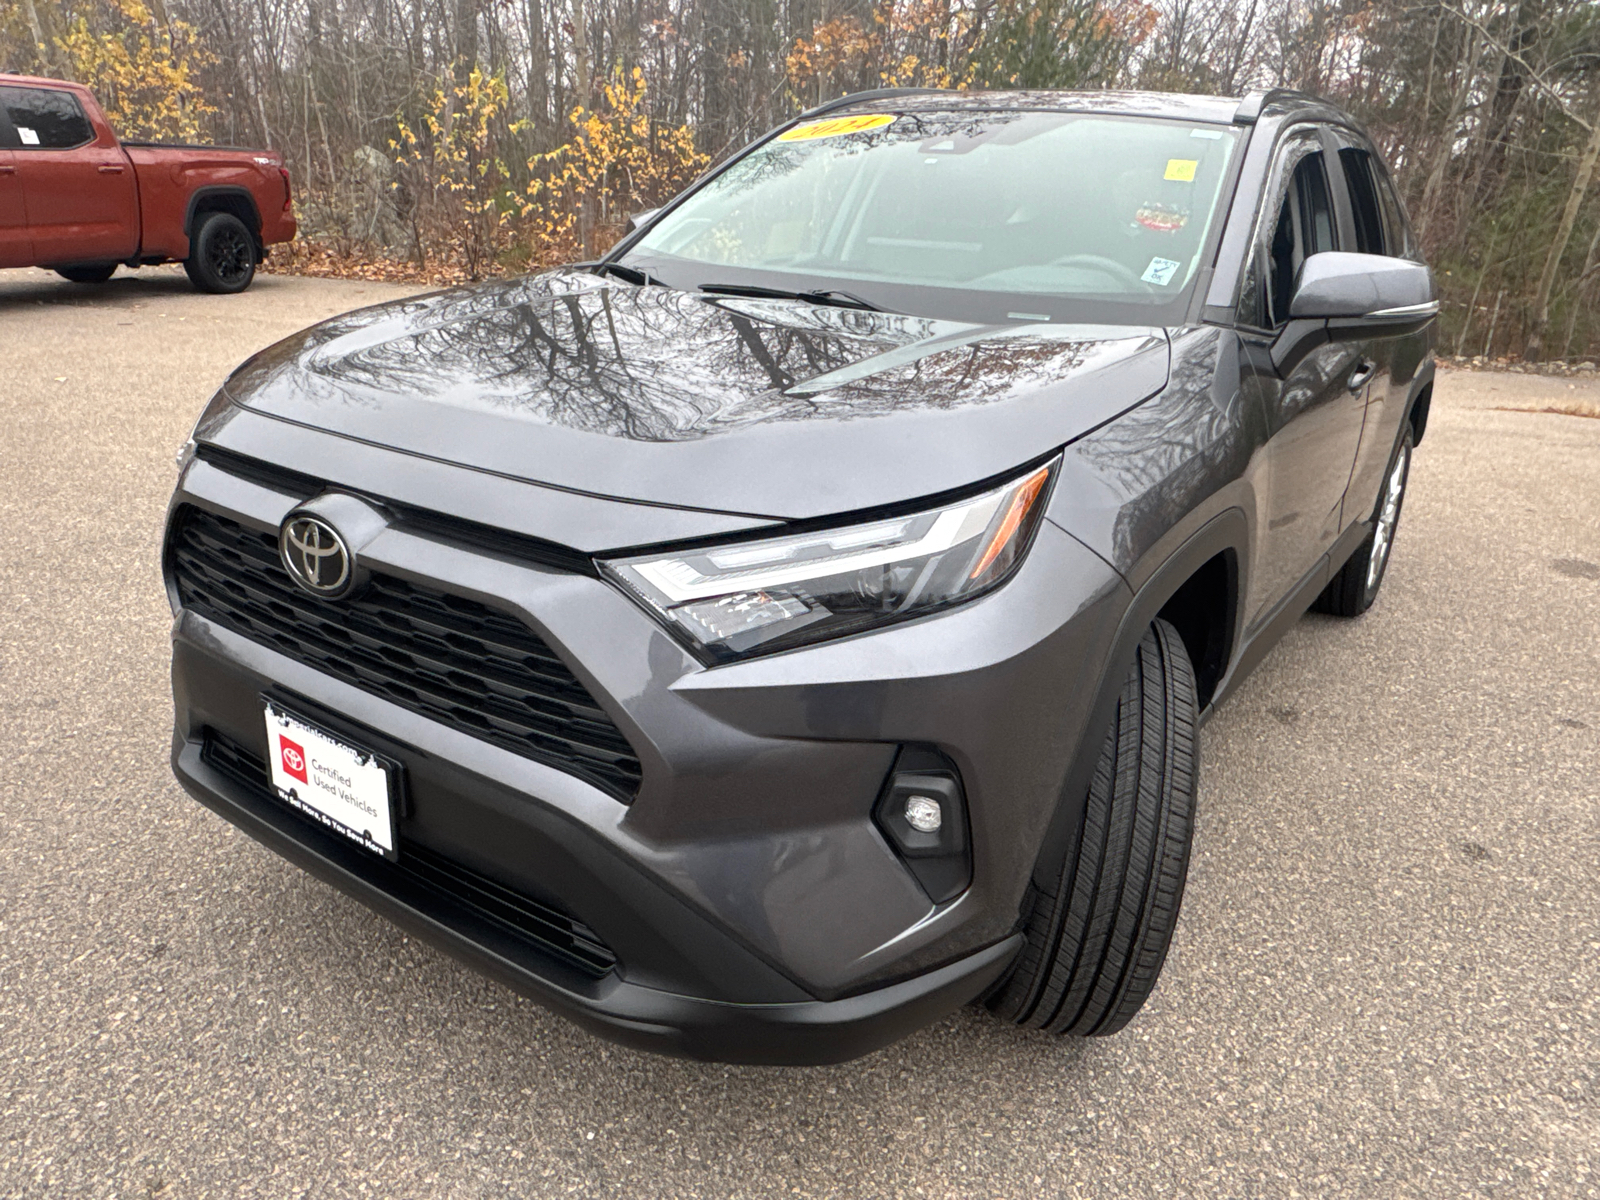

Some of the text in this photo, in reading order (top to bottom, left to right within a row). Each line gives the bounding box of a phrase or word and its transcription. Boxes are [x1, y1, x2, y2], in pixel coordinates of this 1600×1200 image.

[311, 758, 352, 788] Certified
[313, 775, 378, 818] Used Vehicles
[277, 789, 289, 801] We
[321, 814, 331, 826] So
[331, 820, 346, 834] You
[364, 839, 384, 855] More
